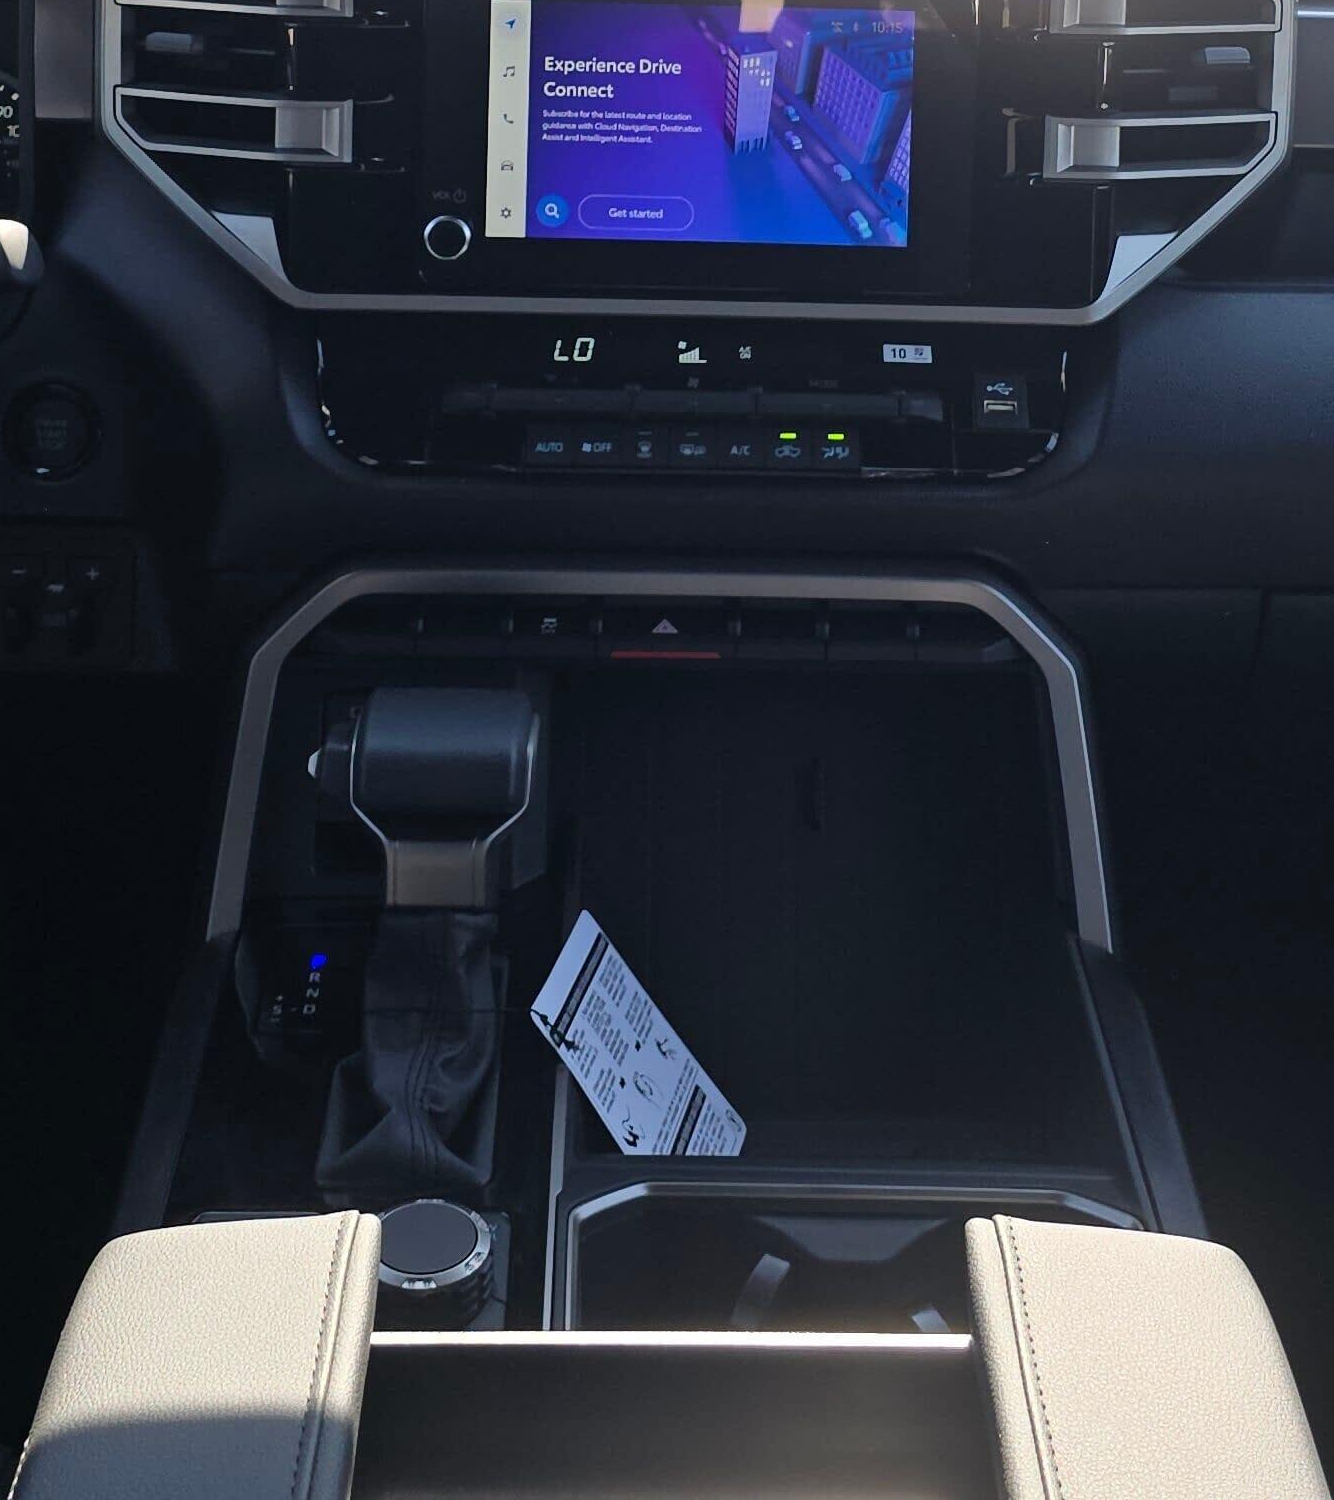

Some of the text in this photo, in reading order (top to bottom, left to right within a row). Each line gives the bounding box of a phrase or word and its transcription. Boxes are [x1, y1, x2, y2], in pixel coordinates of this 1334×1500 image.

[872, 21, 903, 34] 10:15
[544, 56, 682, 75] Experience Drive
[543, 81, 614, 99] Connect
[580, 110, 590, 118] for
[591, 110, 603, 119] the
[605, 111, 626, 119] latest
[626, 112, 646, 120] route
[647, 112, 661, 120] and
[663, 112, 692, 121] location
[578, 122, 593, 130] with
[594, 122, 617, 131] Cloud
[660, 124, 703, 132] Destination
[608, 207, 664, 219] Get started
[552, 336, 596, 363] LO
[535, 441, 564, 453] AUTO
[593, 441, 613, 453] OFF
[729, 444, 751, 456] A/C
[308, 972, 321, 984] R
[305, 987, 320, 998] N
[302, 1003, 316, 1016] D
